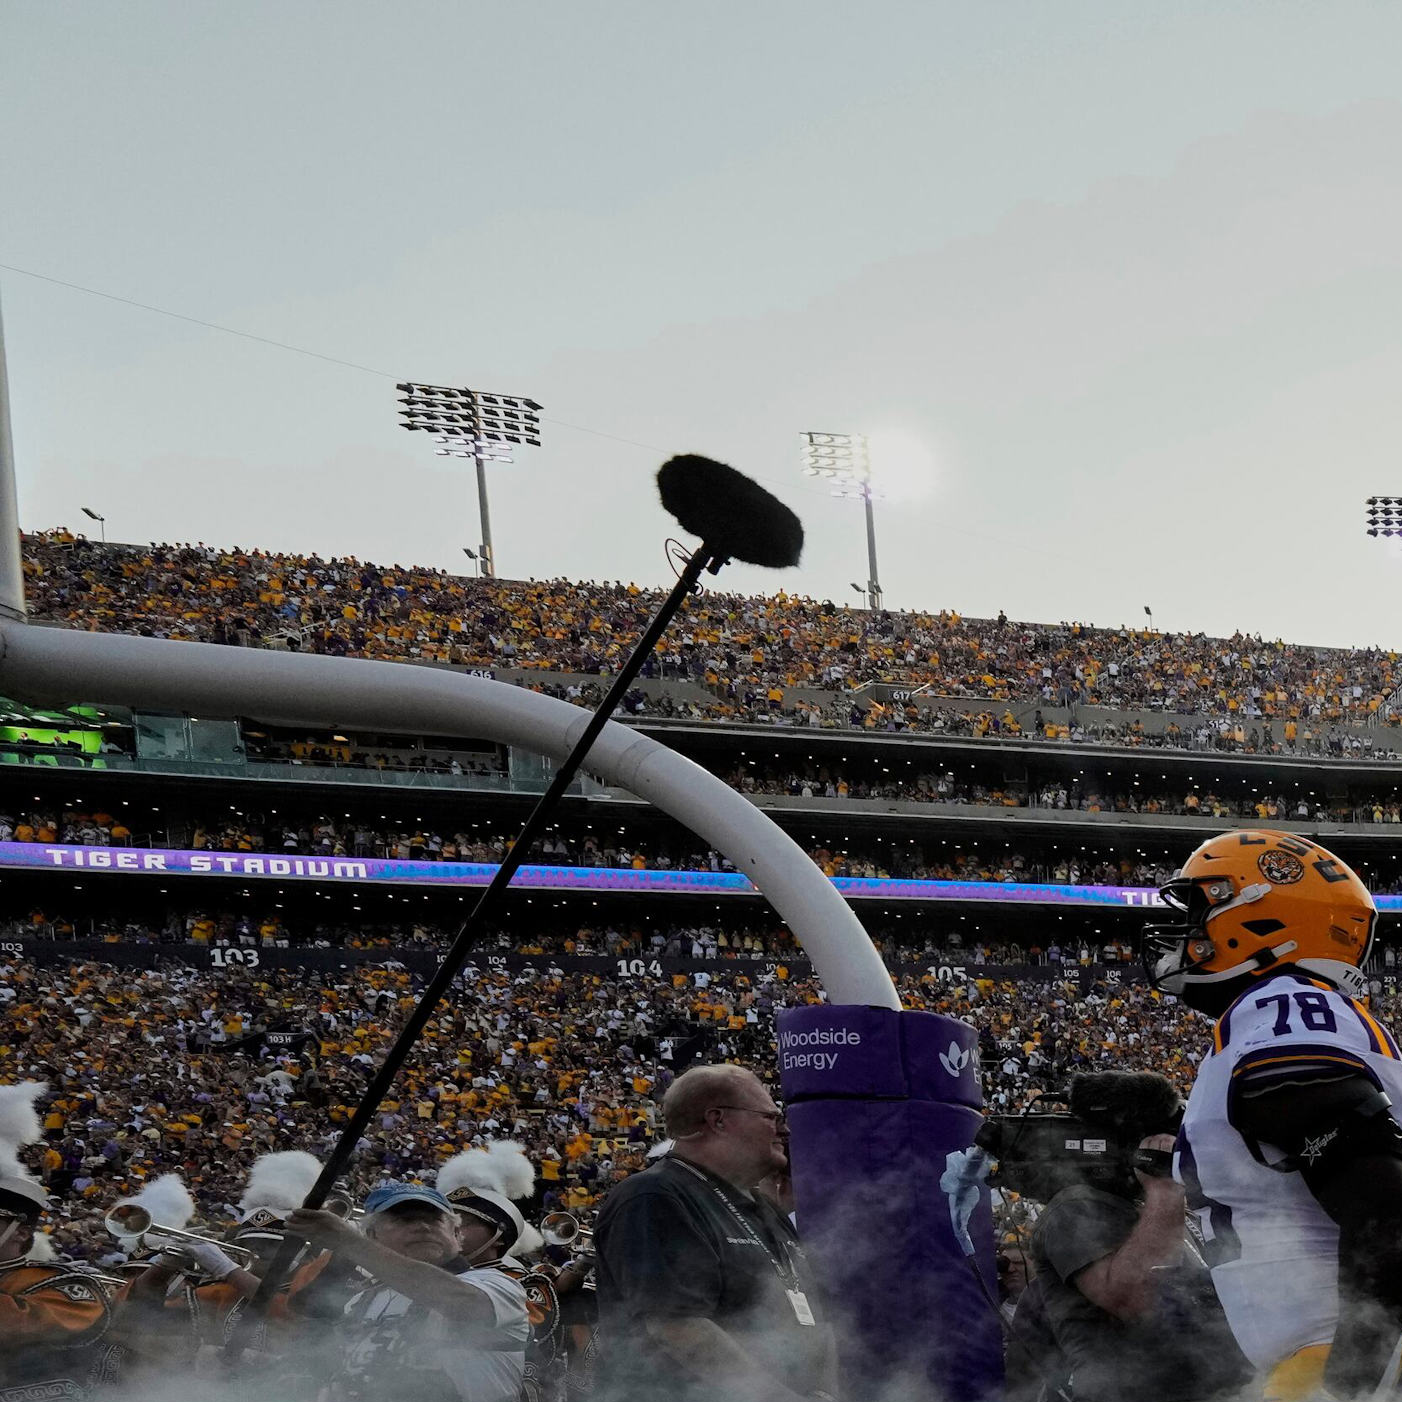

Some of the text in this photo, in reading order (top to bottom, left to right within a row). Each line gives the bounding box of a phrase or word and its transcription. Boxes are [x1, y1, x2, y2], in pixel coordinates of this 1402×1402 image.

[893, 690, 911, 701] 617
[46, 848, 367, 879] TIGER STADIUM
[1, 942, 24, 952] 103
[210, 948, 260, 968] 103
[436, 954, 448, 964] 10
[488, 956, 507, 965] 104
[617, 959, 663, 978] 104
[926, 965, 968, 983] 105
[1063, 969, 1080, 978] 105
[1255, 991, 1338, 1037] 78
[780, 1027, 861, 1050] Woodside
[783, 1052, 839, 1071] Energy
